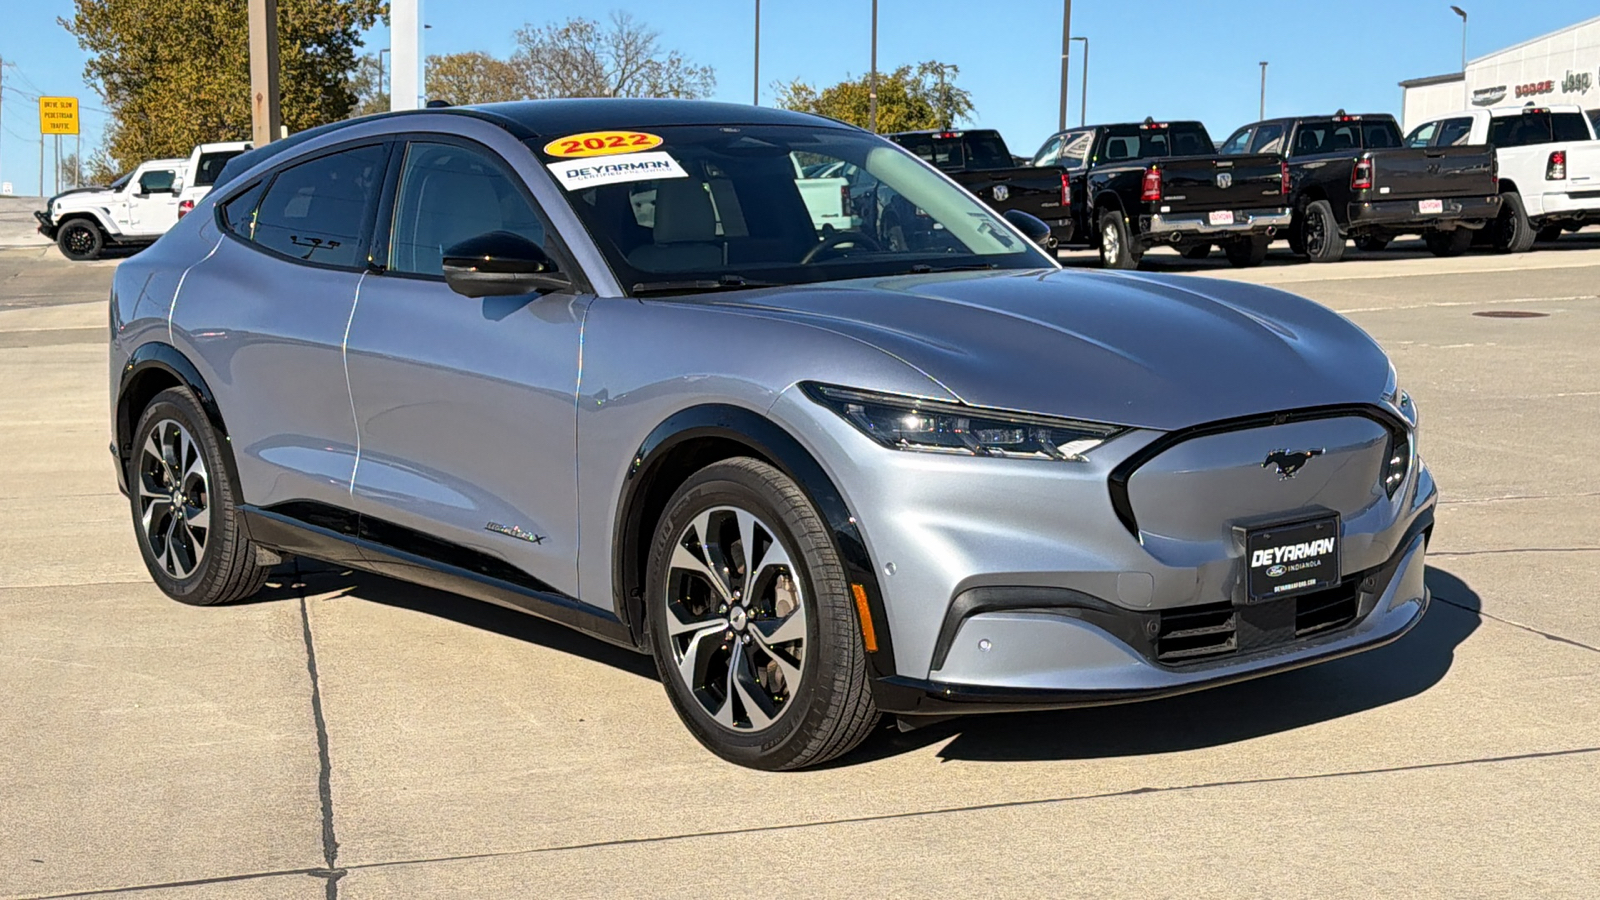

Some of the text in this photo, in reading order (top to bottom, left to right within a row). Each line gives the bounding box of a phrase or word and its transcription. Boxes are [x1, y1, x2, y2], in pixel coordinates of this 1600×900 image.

[1515, 80, 1555, 98] DODGE
[1562, 70, 1592, 95] Jeep
[561, 134, 653, 154] 2022
[566, 161, 670, 178] DEYARMAN
[1251, 537, 1335, 568] DEYARMAN
[1288, 560, 1321, 572] INDIANOLA
